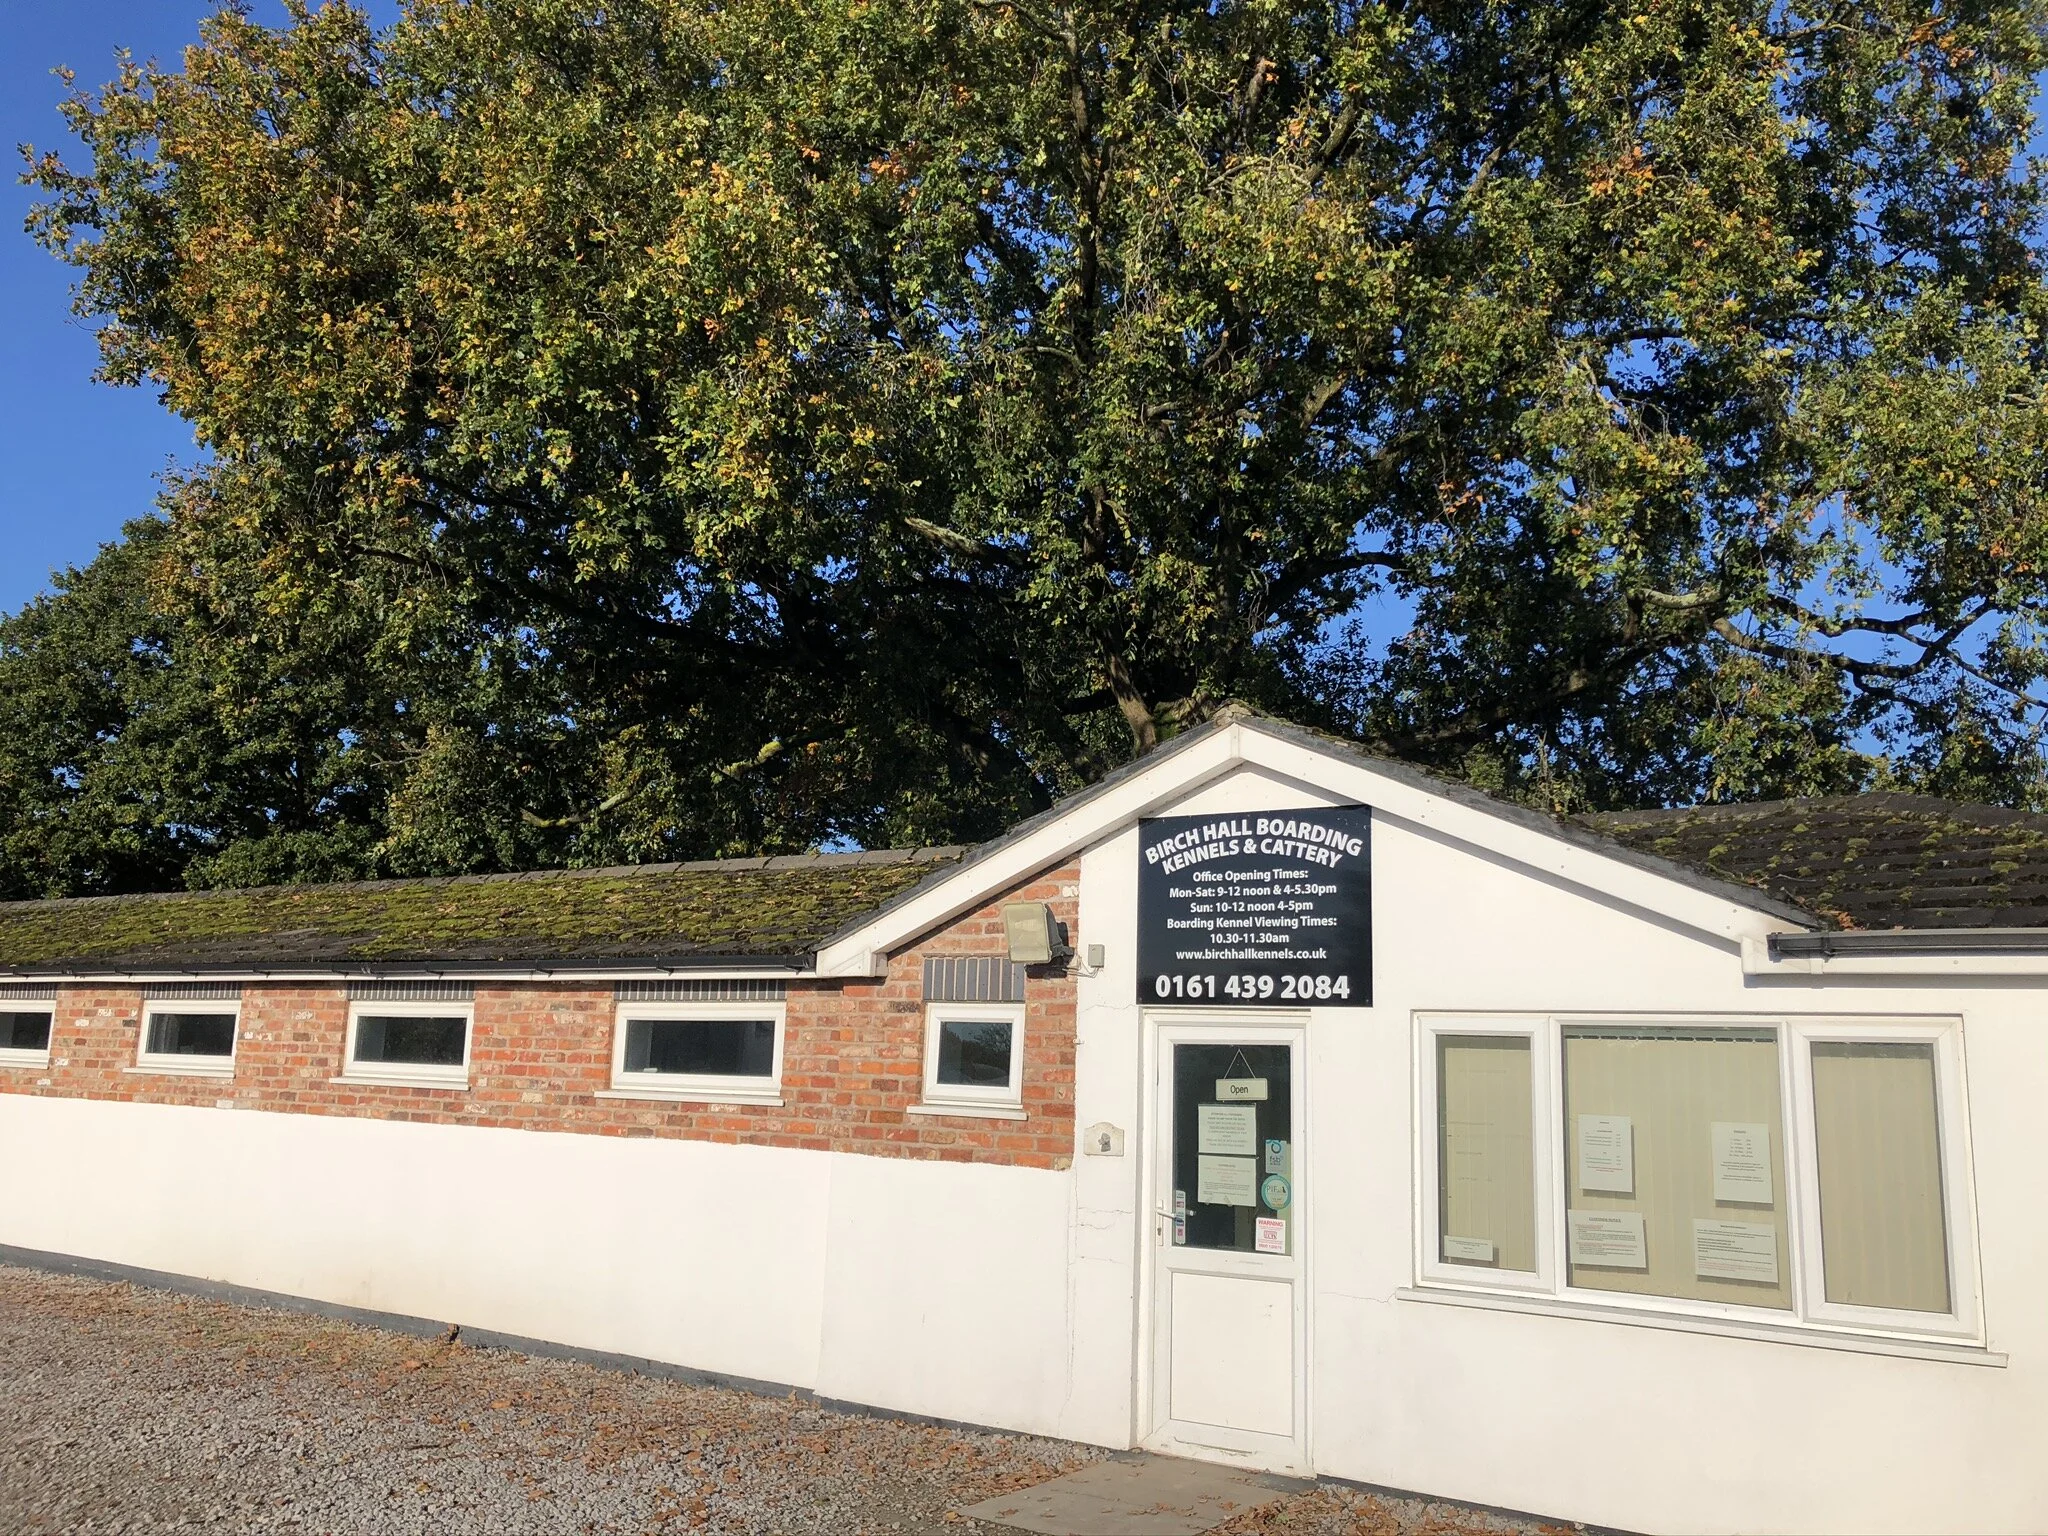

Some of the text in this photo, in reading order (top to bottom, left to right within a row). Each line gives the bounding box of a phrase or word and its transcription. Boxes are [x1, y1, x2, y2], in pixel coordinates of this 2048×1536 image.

[1145, 818, 1363, 865] BIRCH HALL BOARDING
[1162, 838, 1343, 875] KENNELS & CATTERY
[1193, 869, 1308, 883] Office Opening Times:
[1170, 884, 1336, 898] Mon-Sat: 9-12 noon & 4-5.30pm
[1191, 901, 1313, 913] Sun: 10-12 noon 4-5pm
[1167, 916, 1337, 930] Boarding Kennel Viewing Times:
[1210, 933, 1289, 943] 10.30-11.30am
[1176, 948, 1326, 960] www.birchhallkennels.co.uk
[1156, 975, 1350, 999] 0161 439 2084
[1230, 1085, 1249, 1096] Open
